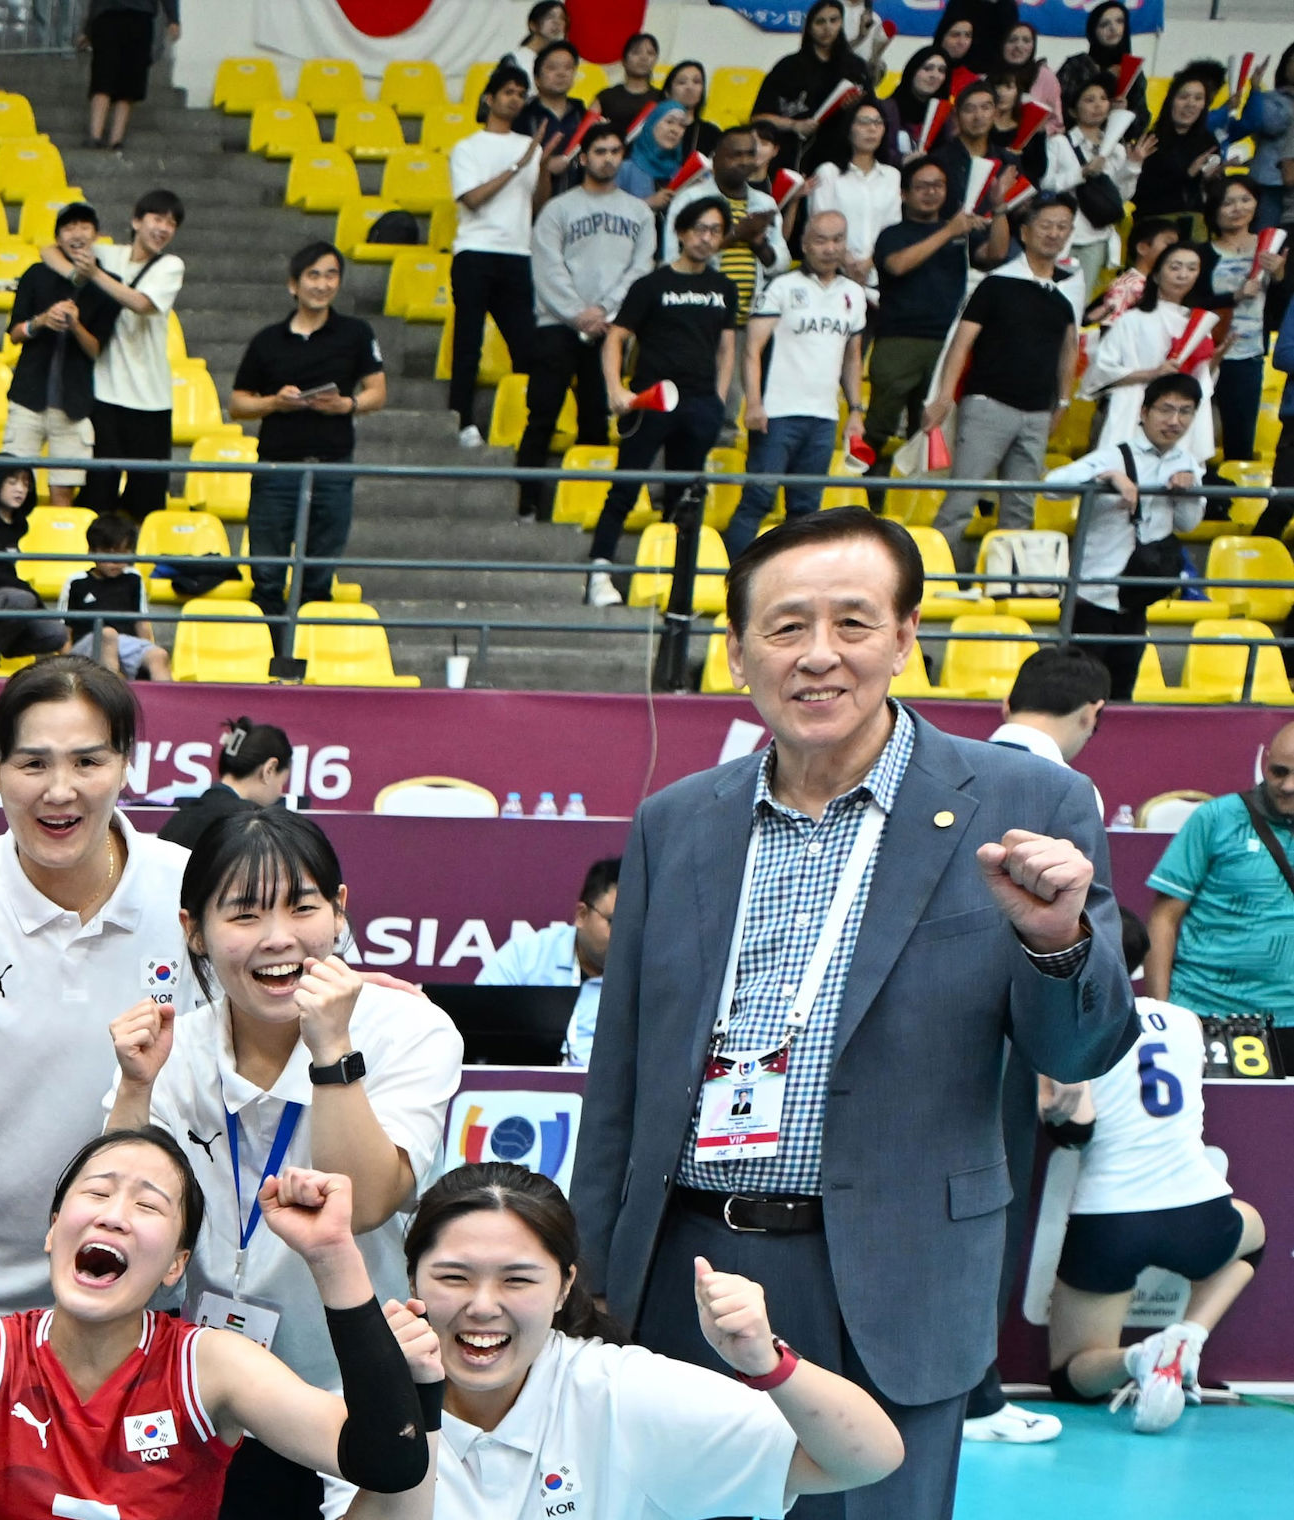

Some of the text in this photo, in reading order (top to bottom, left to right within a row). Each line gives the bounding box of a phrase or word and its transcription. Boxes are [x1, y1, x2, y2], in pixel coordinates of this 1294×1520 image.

[571, 212, 641, 244] HOPKINS
[1232, 1035, 1270, 1077] 8
[1138, 1043, 1184, 1118] 6
[729, 1135, 747, 1145] VIP
[140, 1448, 170, 1463] KOR
[545, 1501, 576, 1517] KOR
